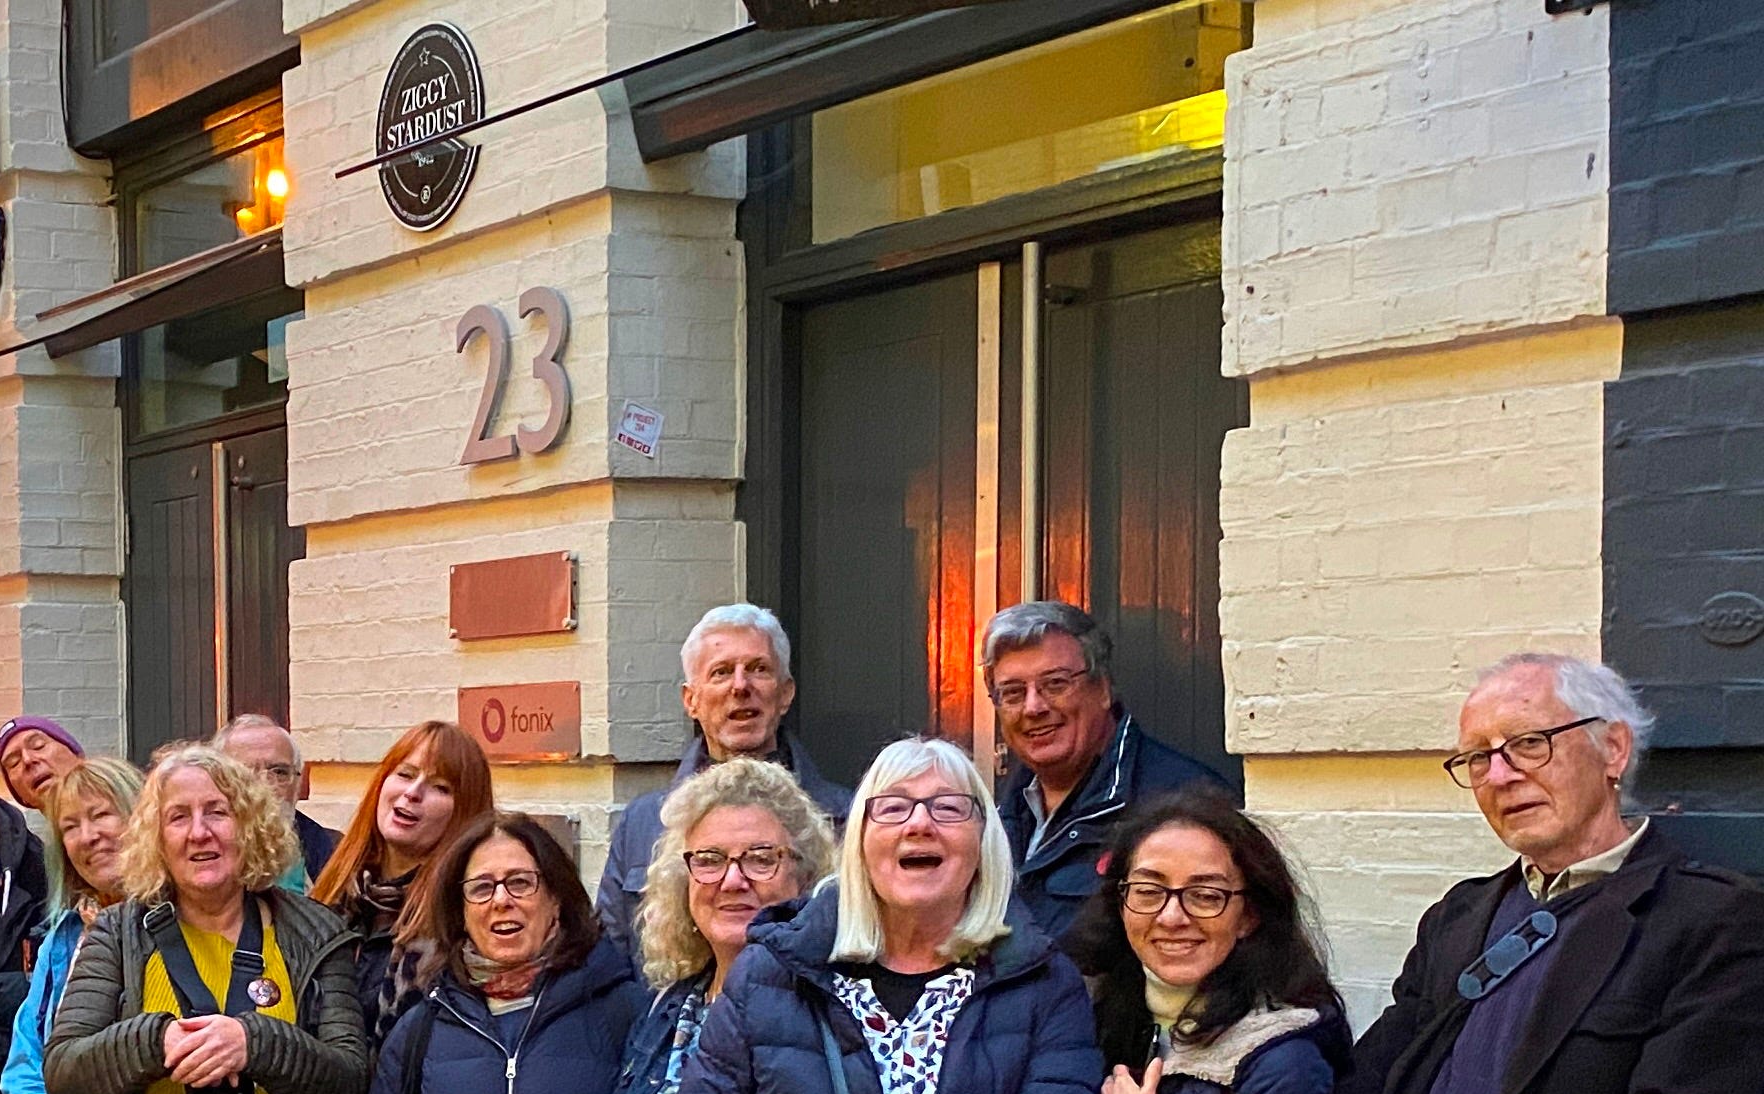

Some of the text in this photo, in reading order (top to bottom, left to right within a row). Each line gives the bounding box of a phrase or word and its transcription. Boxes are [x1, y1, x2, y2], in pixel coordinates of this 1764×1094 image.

[401, 72, 450, 116] ZIGGY
[387, 99, 466, 151] STARDUST
[456, 286, 572, 466] 23
[510, 706, 555, 733] fonix
